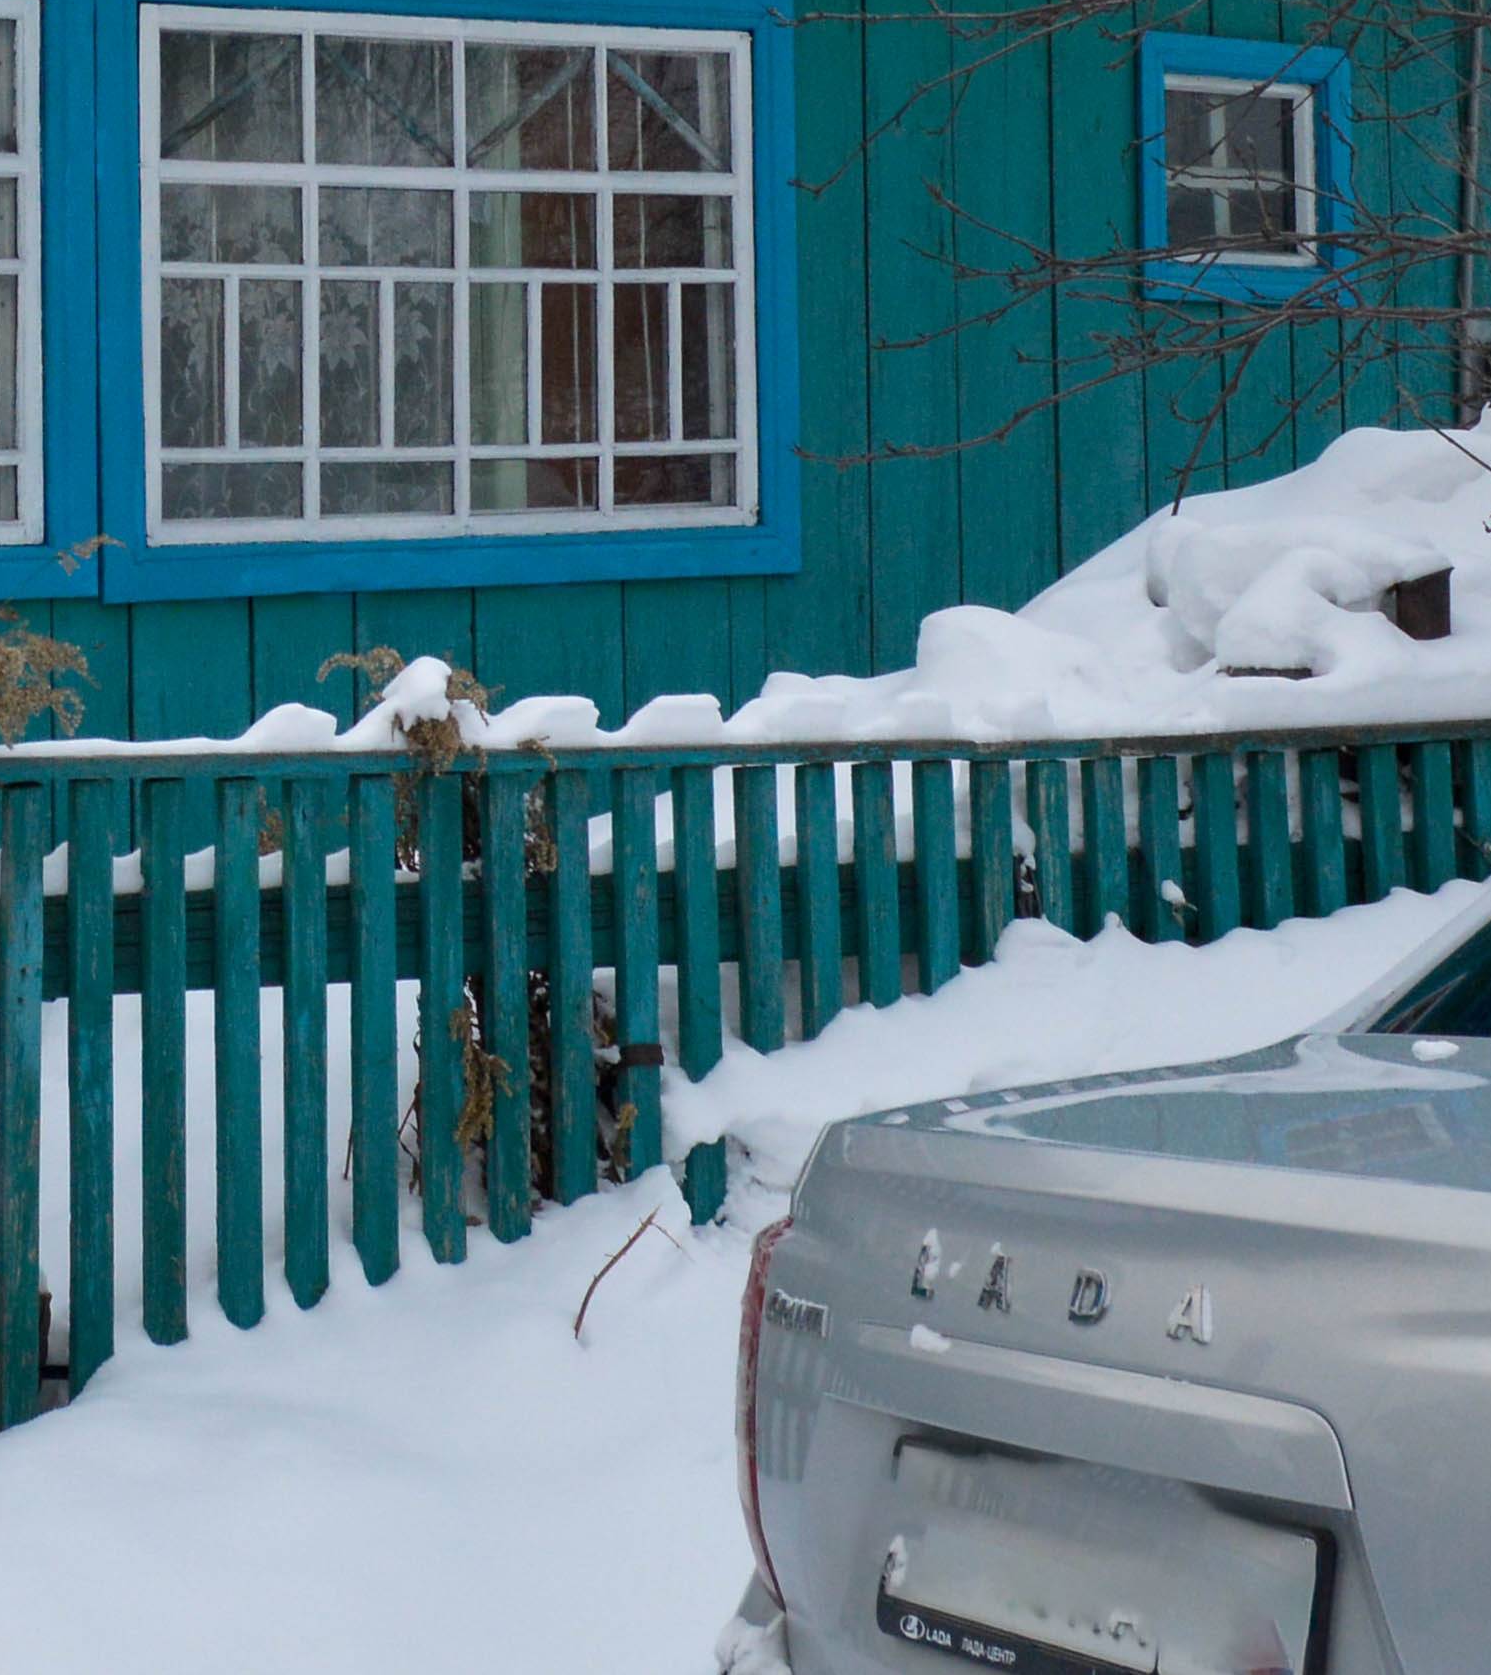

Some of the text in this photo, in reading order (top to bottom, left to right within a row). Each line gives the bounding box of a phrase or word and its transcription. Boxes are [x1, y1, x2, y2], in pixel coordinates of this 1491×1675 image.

[911, 1234, 1213, 1345] LADA
[926, 1628, 952, 1647] LADA
[961, 1636, 1016, 1664] ЛАДА-ЦЕНТР
